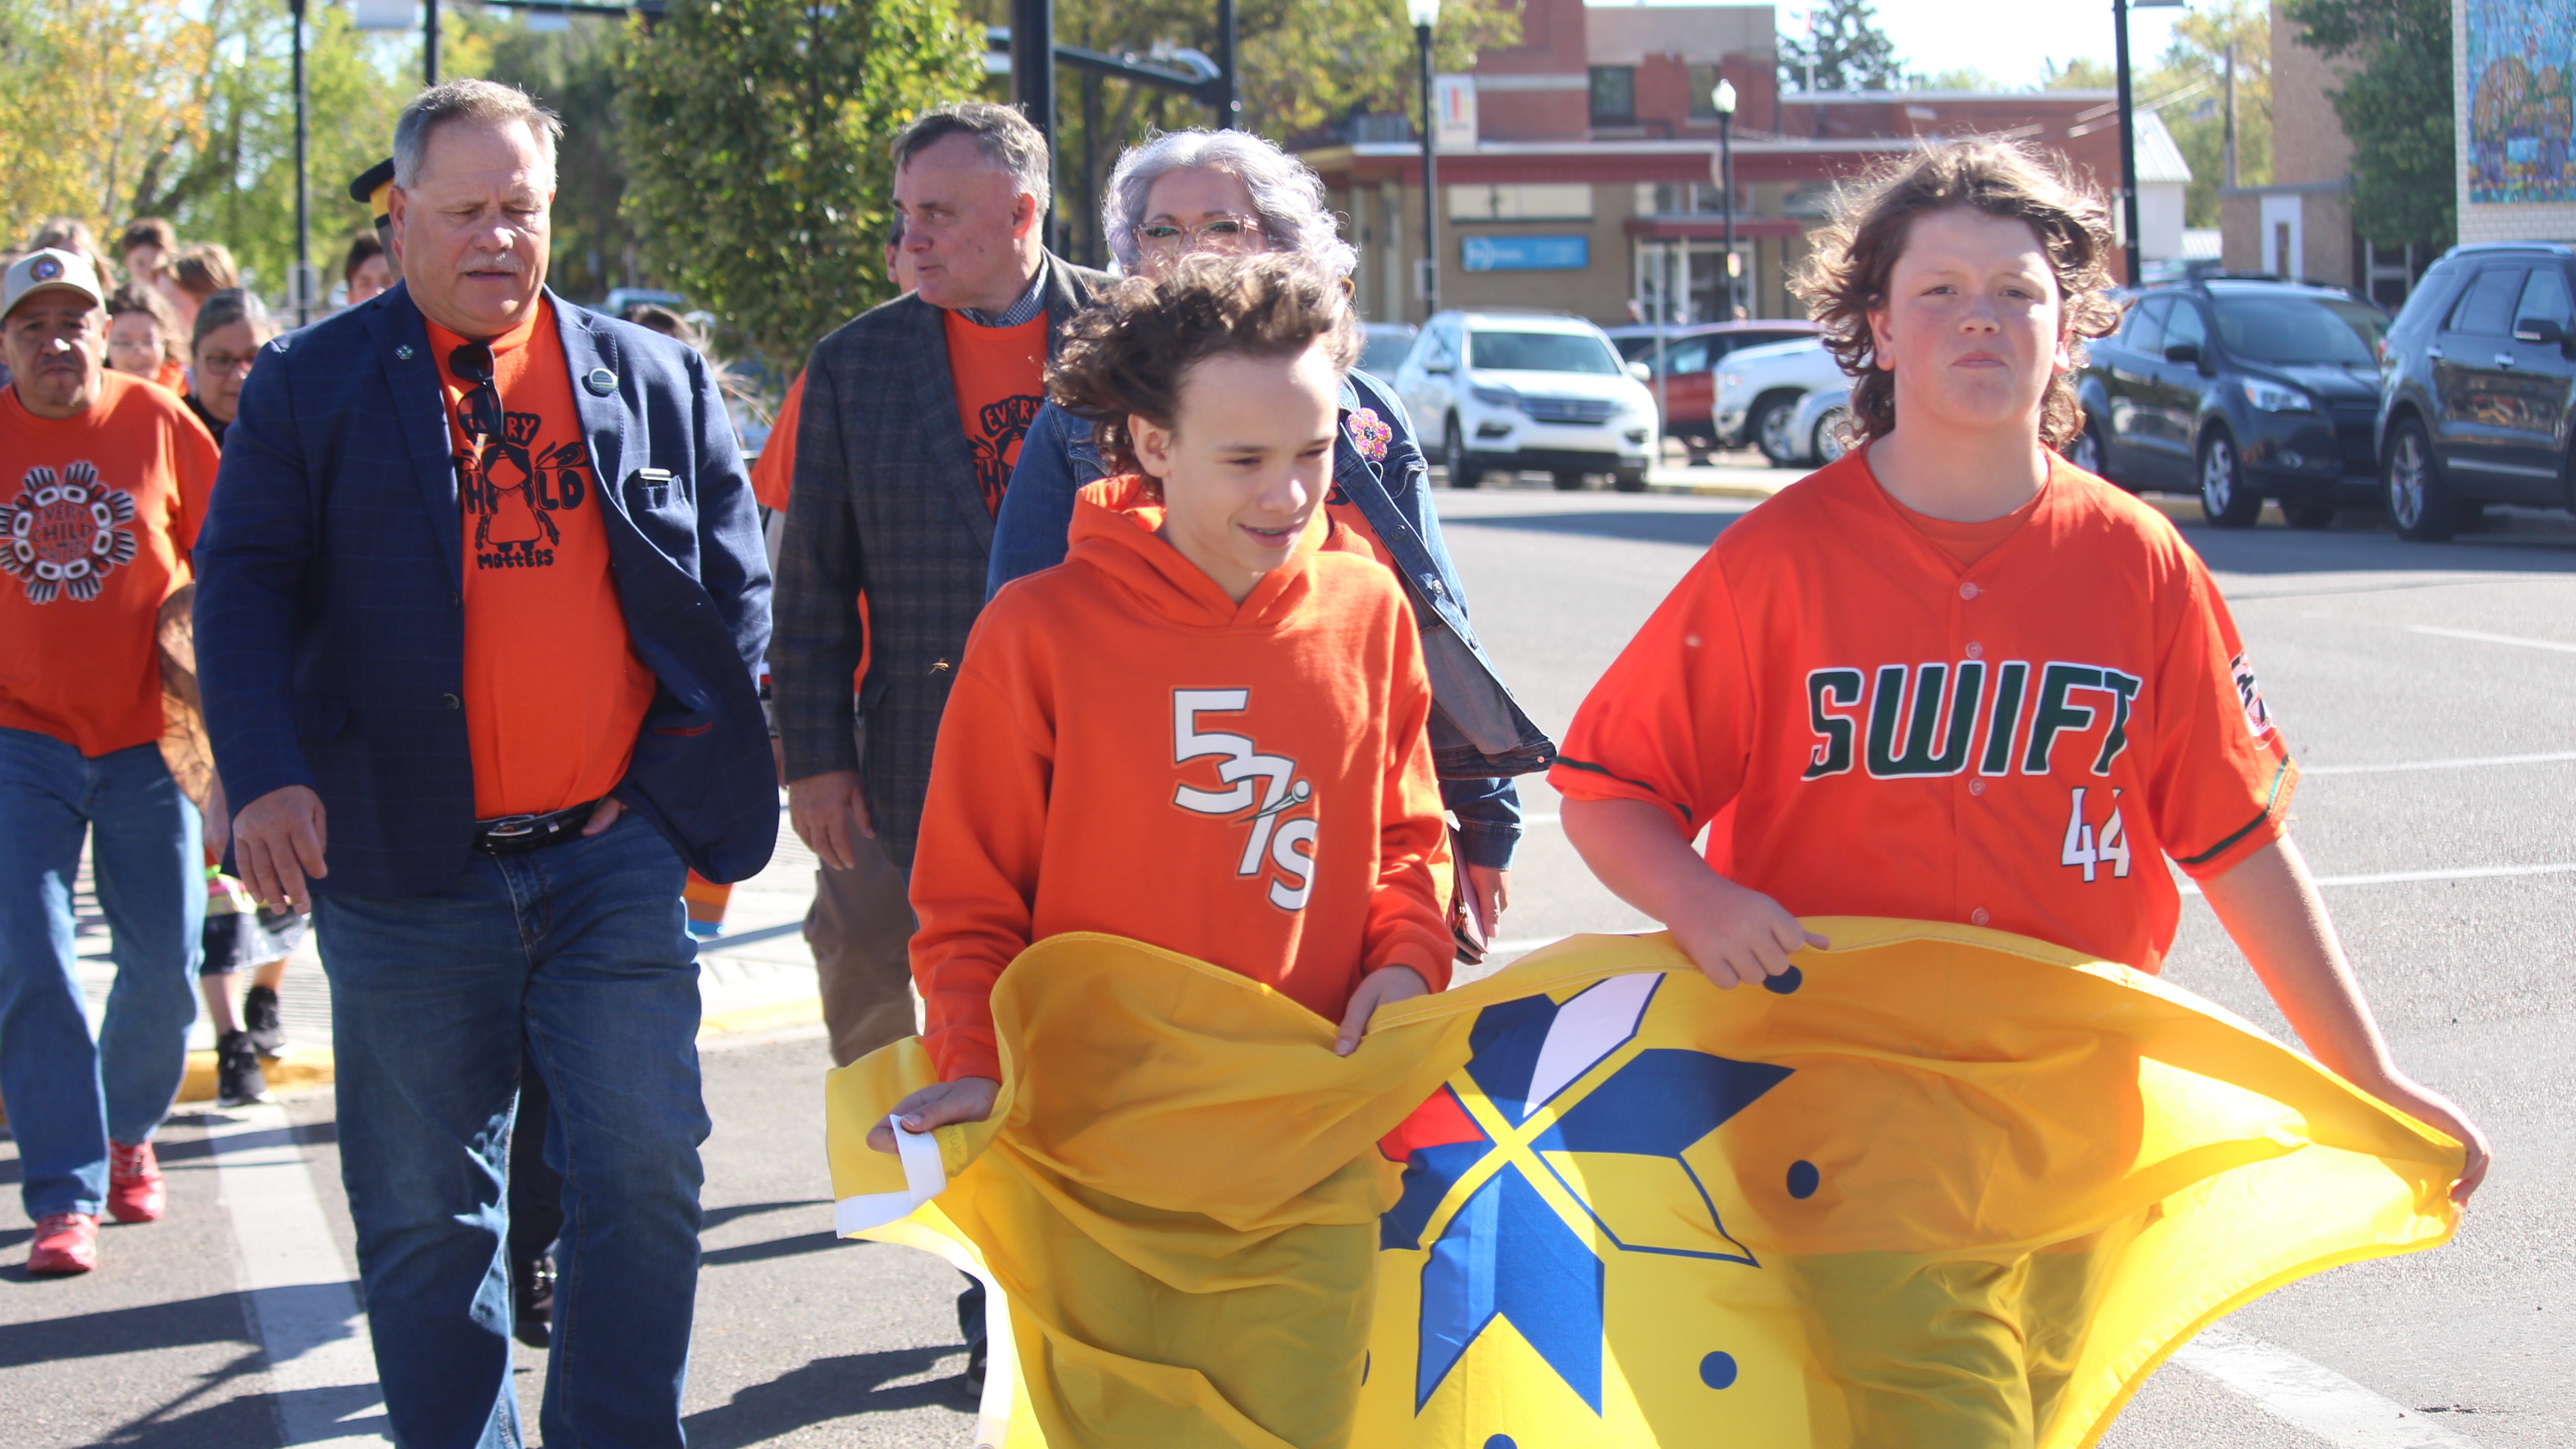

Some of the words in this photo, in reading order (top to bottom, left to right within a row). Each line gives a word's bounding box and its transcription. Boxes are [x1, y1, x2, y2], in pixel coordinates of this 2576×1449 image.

[32, 523, 94, 543] CHILD
[1800, 660, 2143, 782] SWIFT
[2060, 786, 2130, 883] 44
